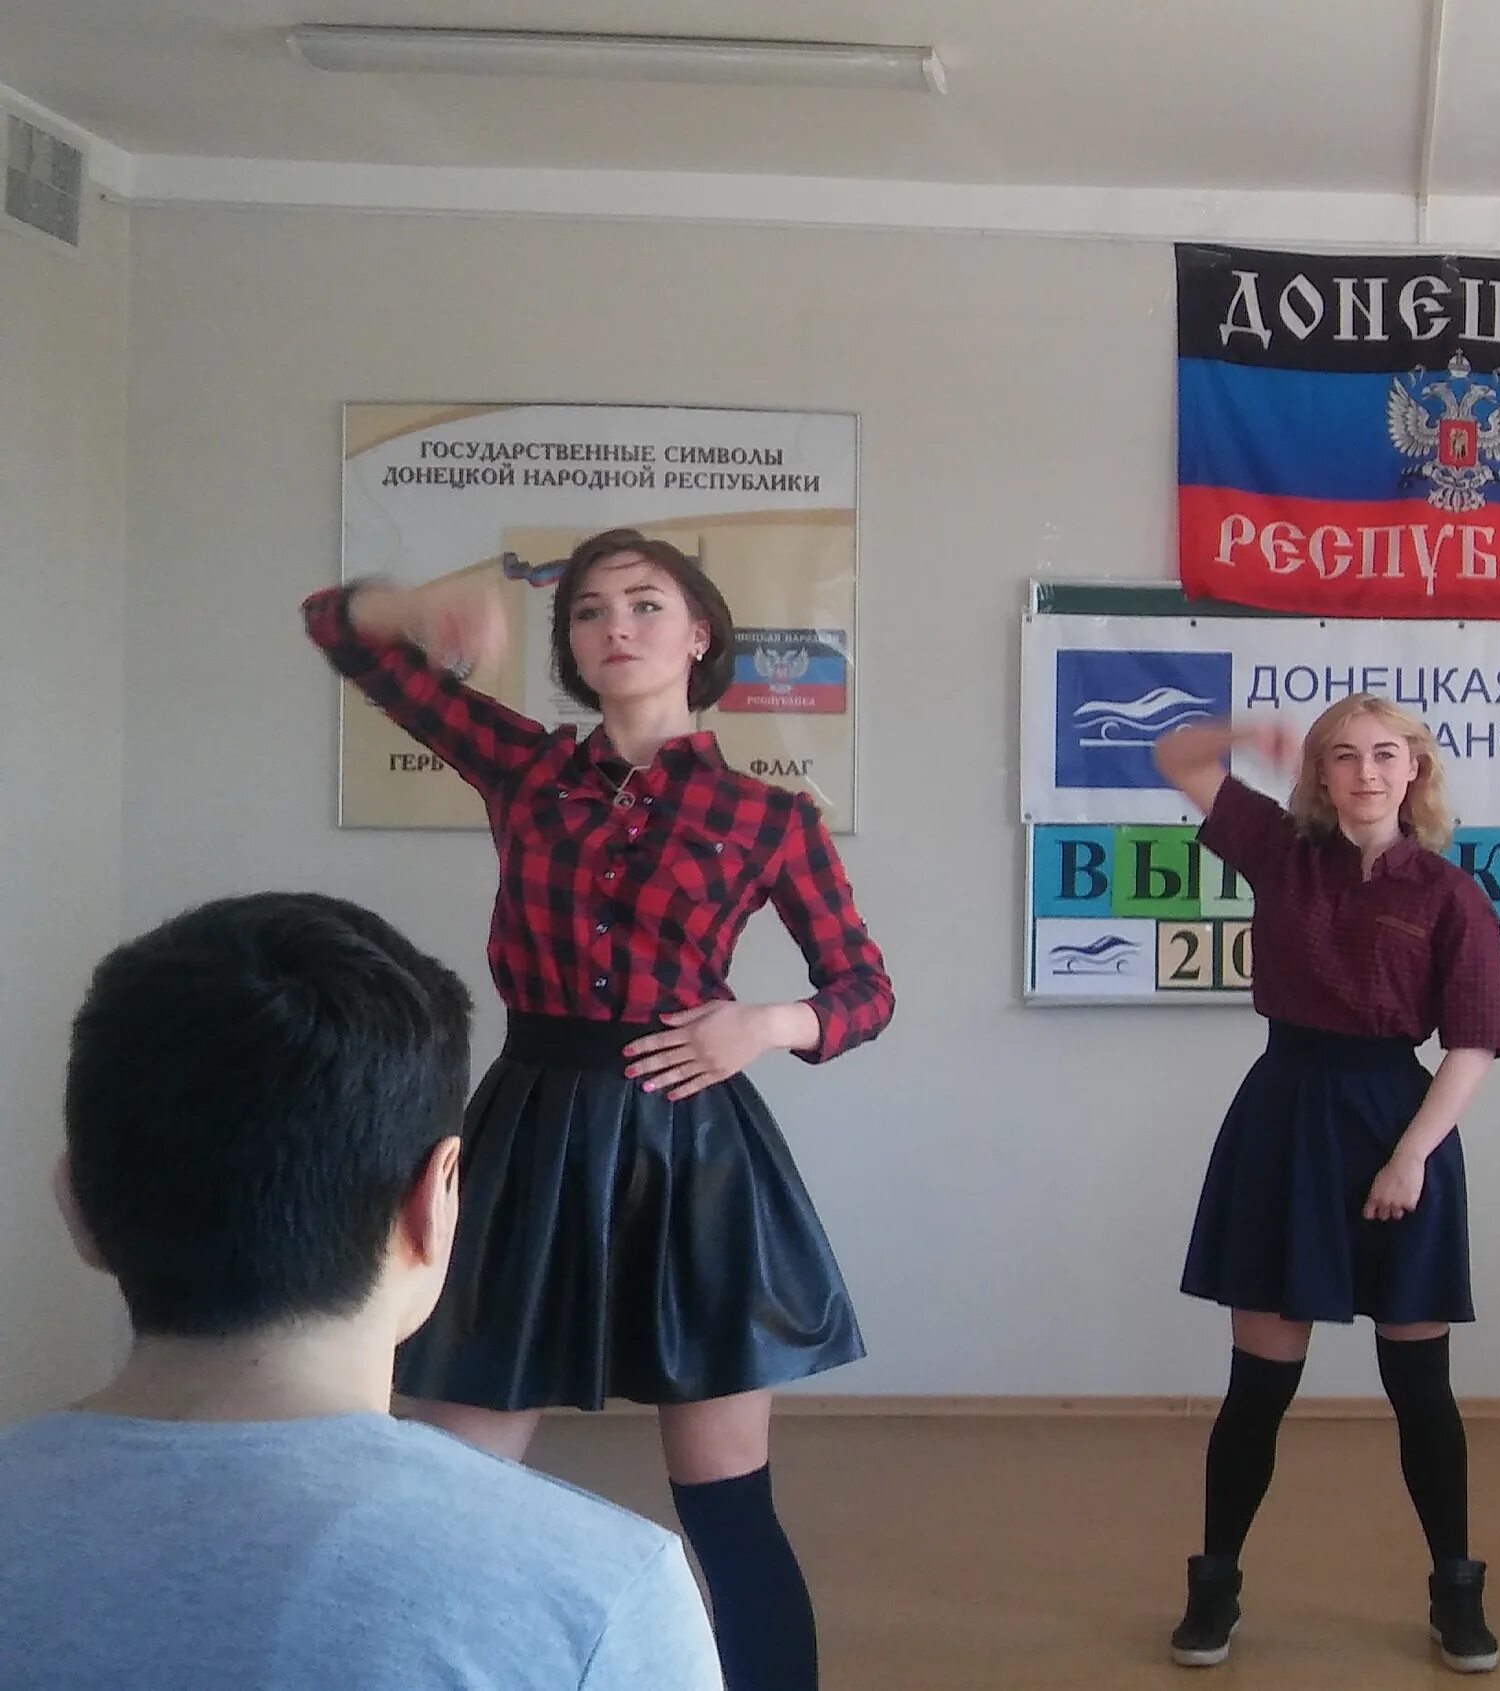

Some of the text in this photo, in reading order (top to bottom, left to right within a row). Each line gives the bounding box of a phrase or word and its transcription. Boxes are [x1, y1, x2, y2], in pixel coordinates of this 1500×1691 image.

[420, 440, 784, 466] ГОСУДАРСТВЕННЫЕ СИМВОЛЫ
[382, 463, 820, 493] ДОНЕЦКОЙ НАРОДНОЙ РЕСПУБЛИКИ
[749, 758, 814, 776] ФЛАГ
